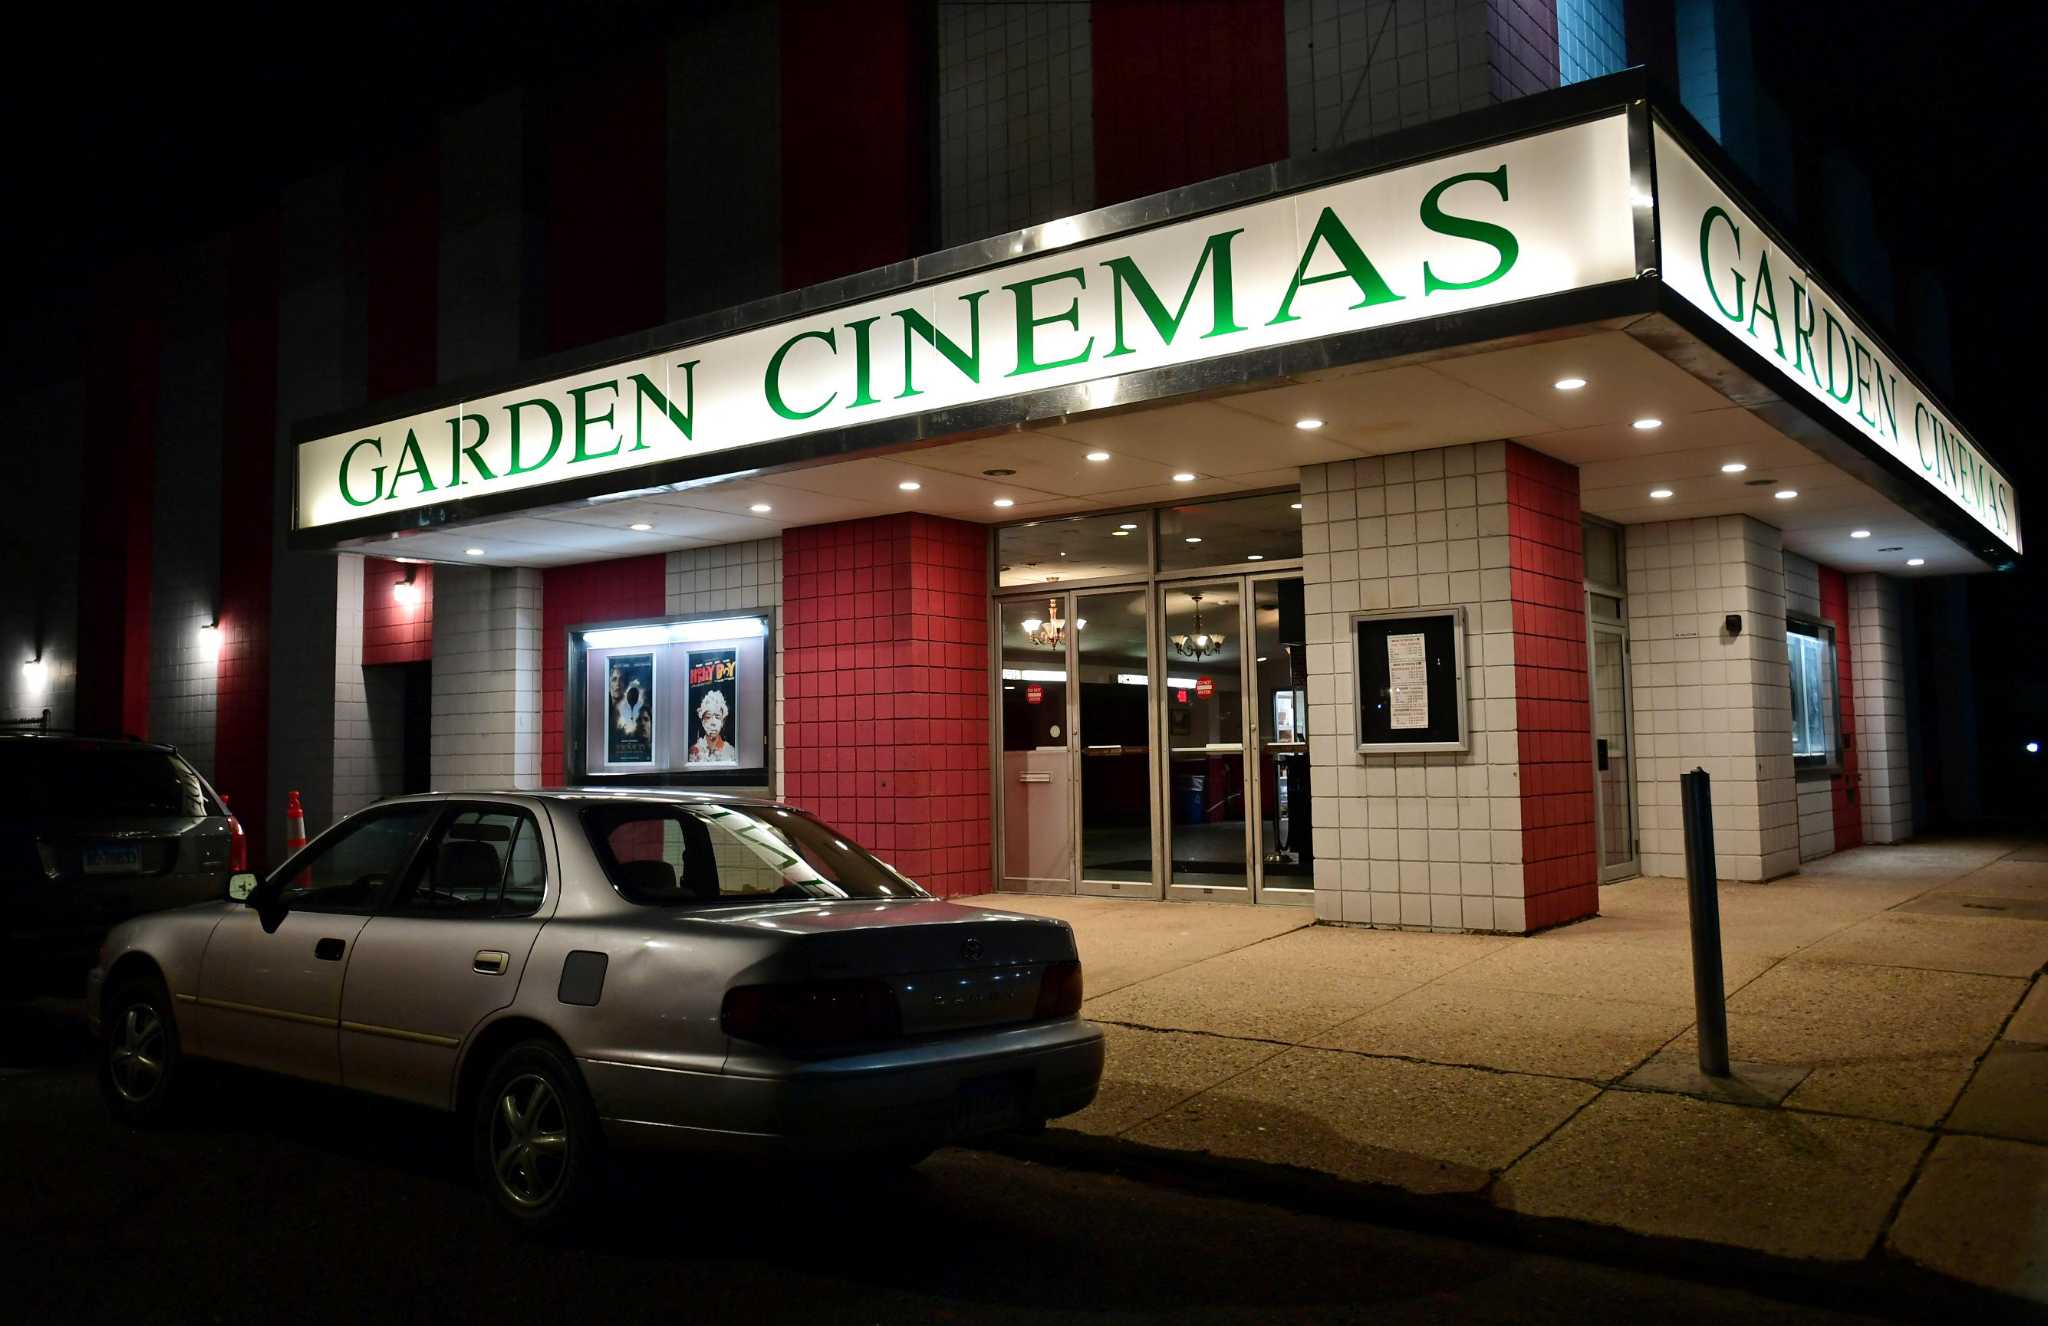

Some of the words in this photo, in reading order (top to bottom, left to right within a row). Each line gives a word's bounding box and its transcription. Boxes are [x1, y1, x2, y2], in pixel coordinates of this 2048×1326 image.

[338, 359, 700, 508] GARDEN
[763, 163, 1521, 422] CINEMAS
[1700, 206, 1898, 446] GARDEN
[1914, 401, 2009, 536] CINEMAS
